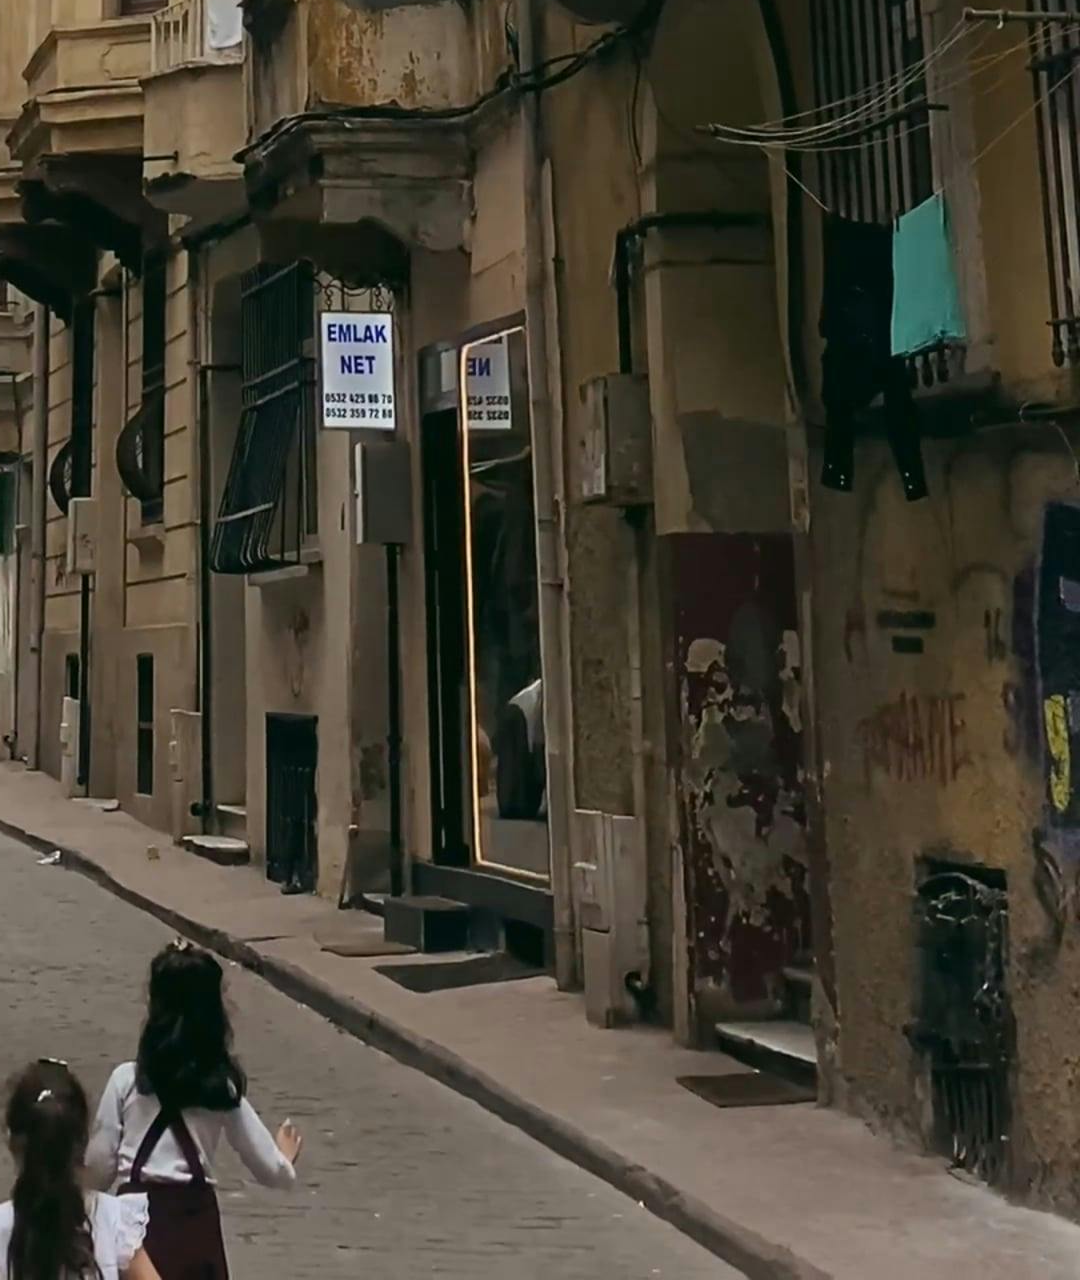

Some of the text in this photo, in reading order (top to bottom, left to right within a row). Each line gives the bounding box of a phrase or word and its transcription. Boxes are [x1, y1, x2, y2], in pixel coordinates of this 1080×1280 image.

[327, 323, 387, 343] EMLAK
[340, 355, 376, 375] NET
[325, 393, 347, 404] 0532
[325, 407, 347, 419] 0532
[368, 408, 380, 419] 72
